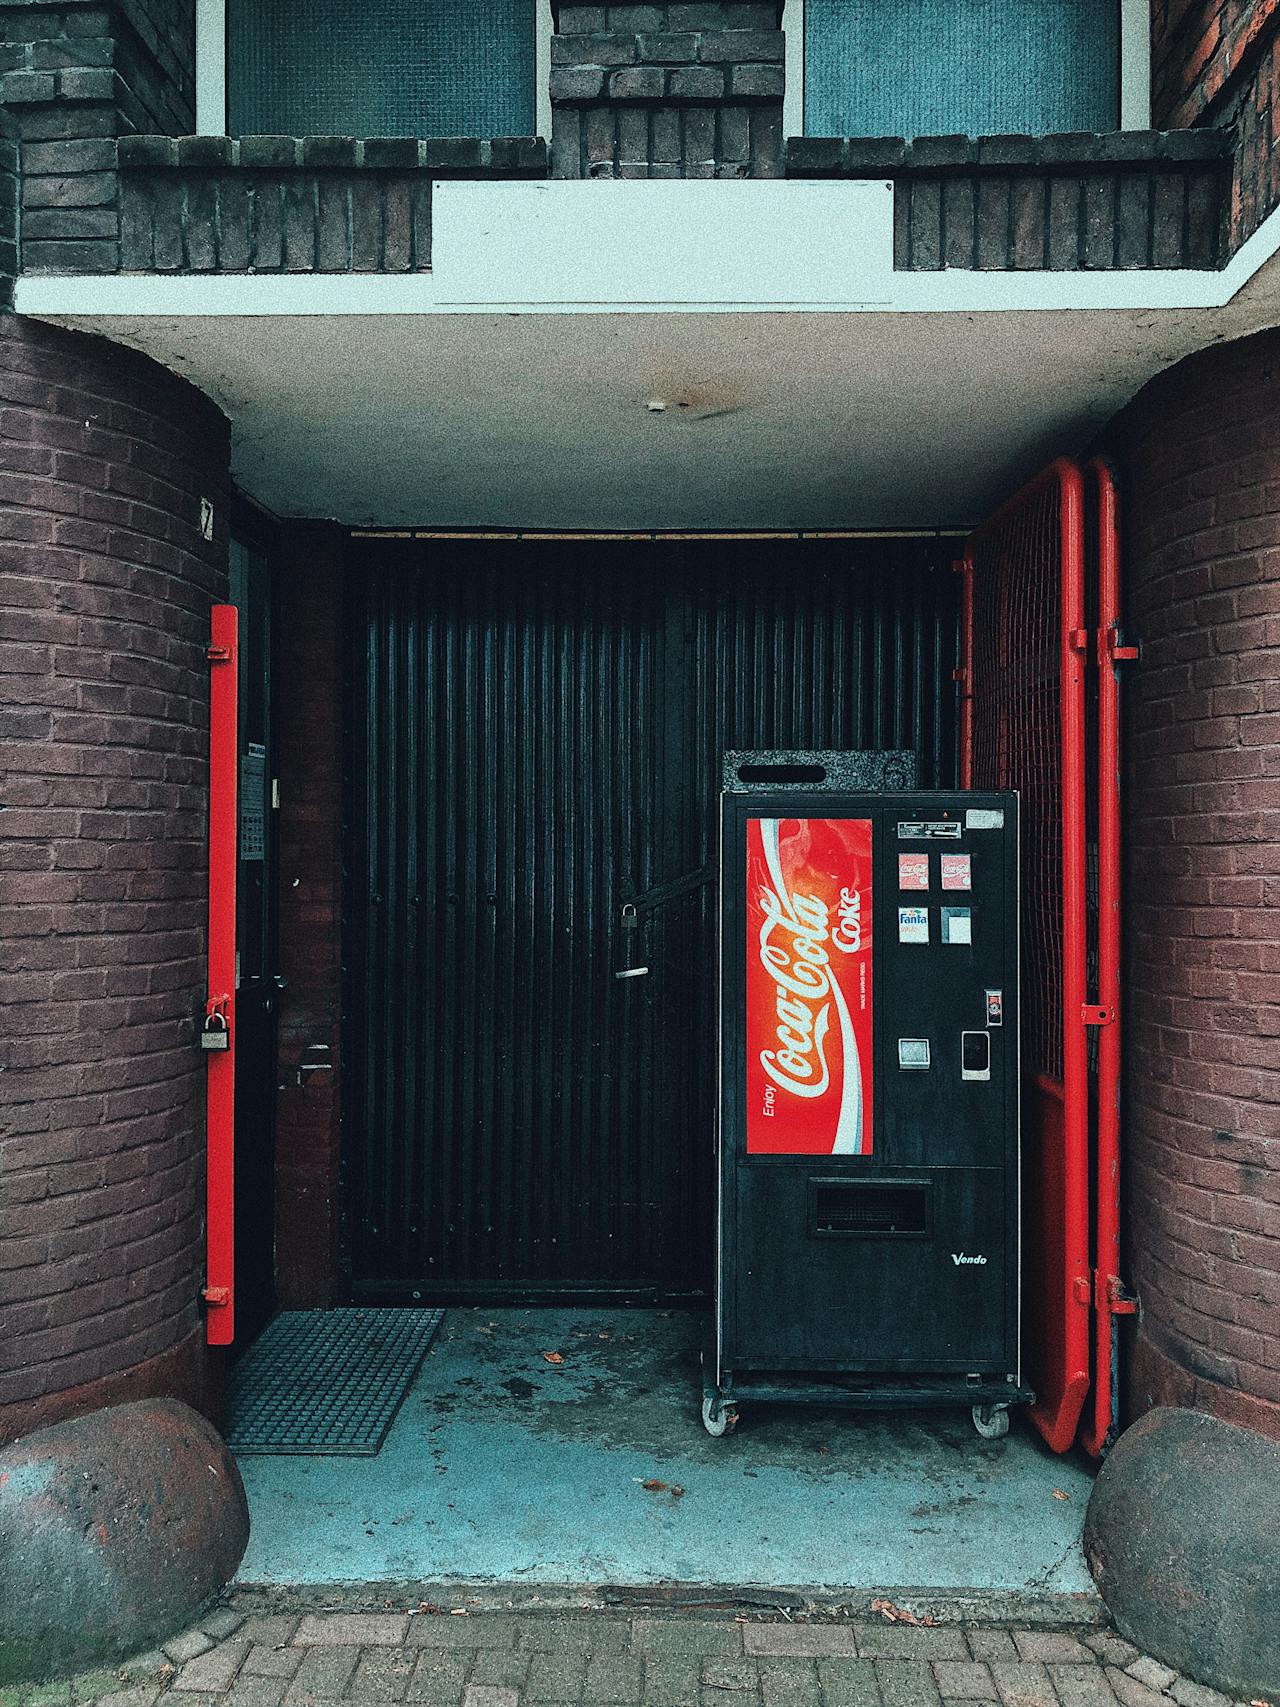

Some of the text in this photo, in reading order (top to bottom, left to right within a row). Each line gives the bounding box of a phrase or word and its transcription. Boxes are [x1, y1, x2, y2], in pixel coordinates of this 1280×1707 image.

[832, 887, 860, 953] Coke
[900, 913, 927, 924] Fanta
[760, 884, 829, 1098] Coca-Cola
[763, 1084, 777, 1117] Enjoy
[951, 1252, 987, 1265] Vendo
